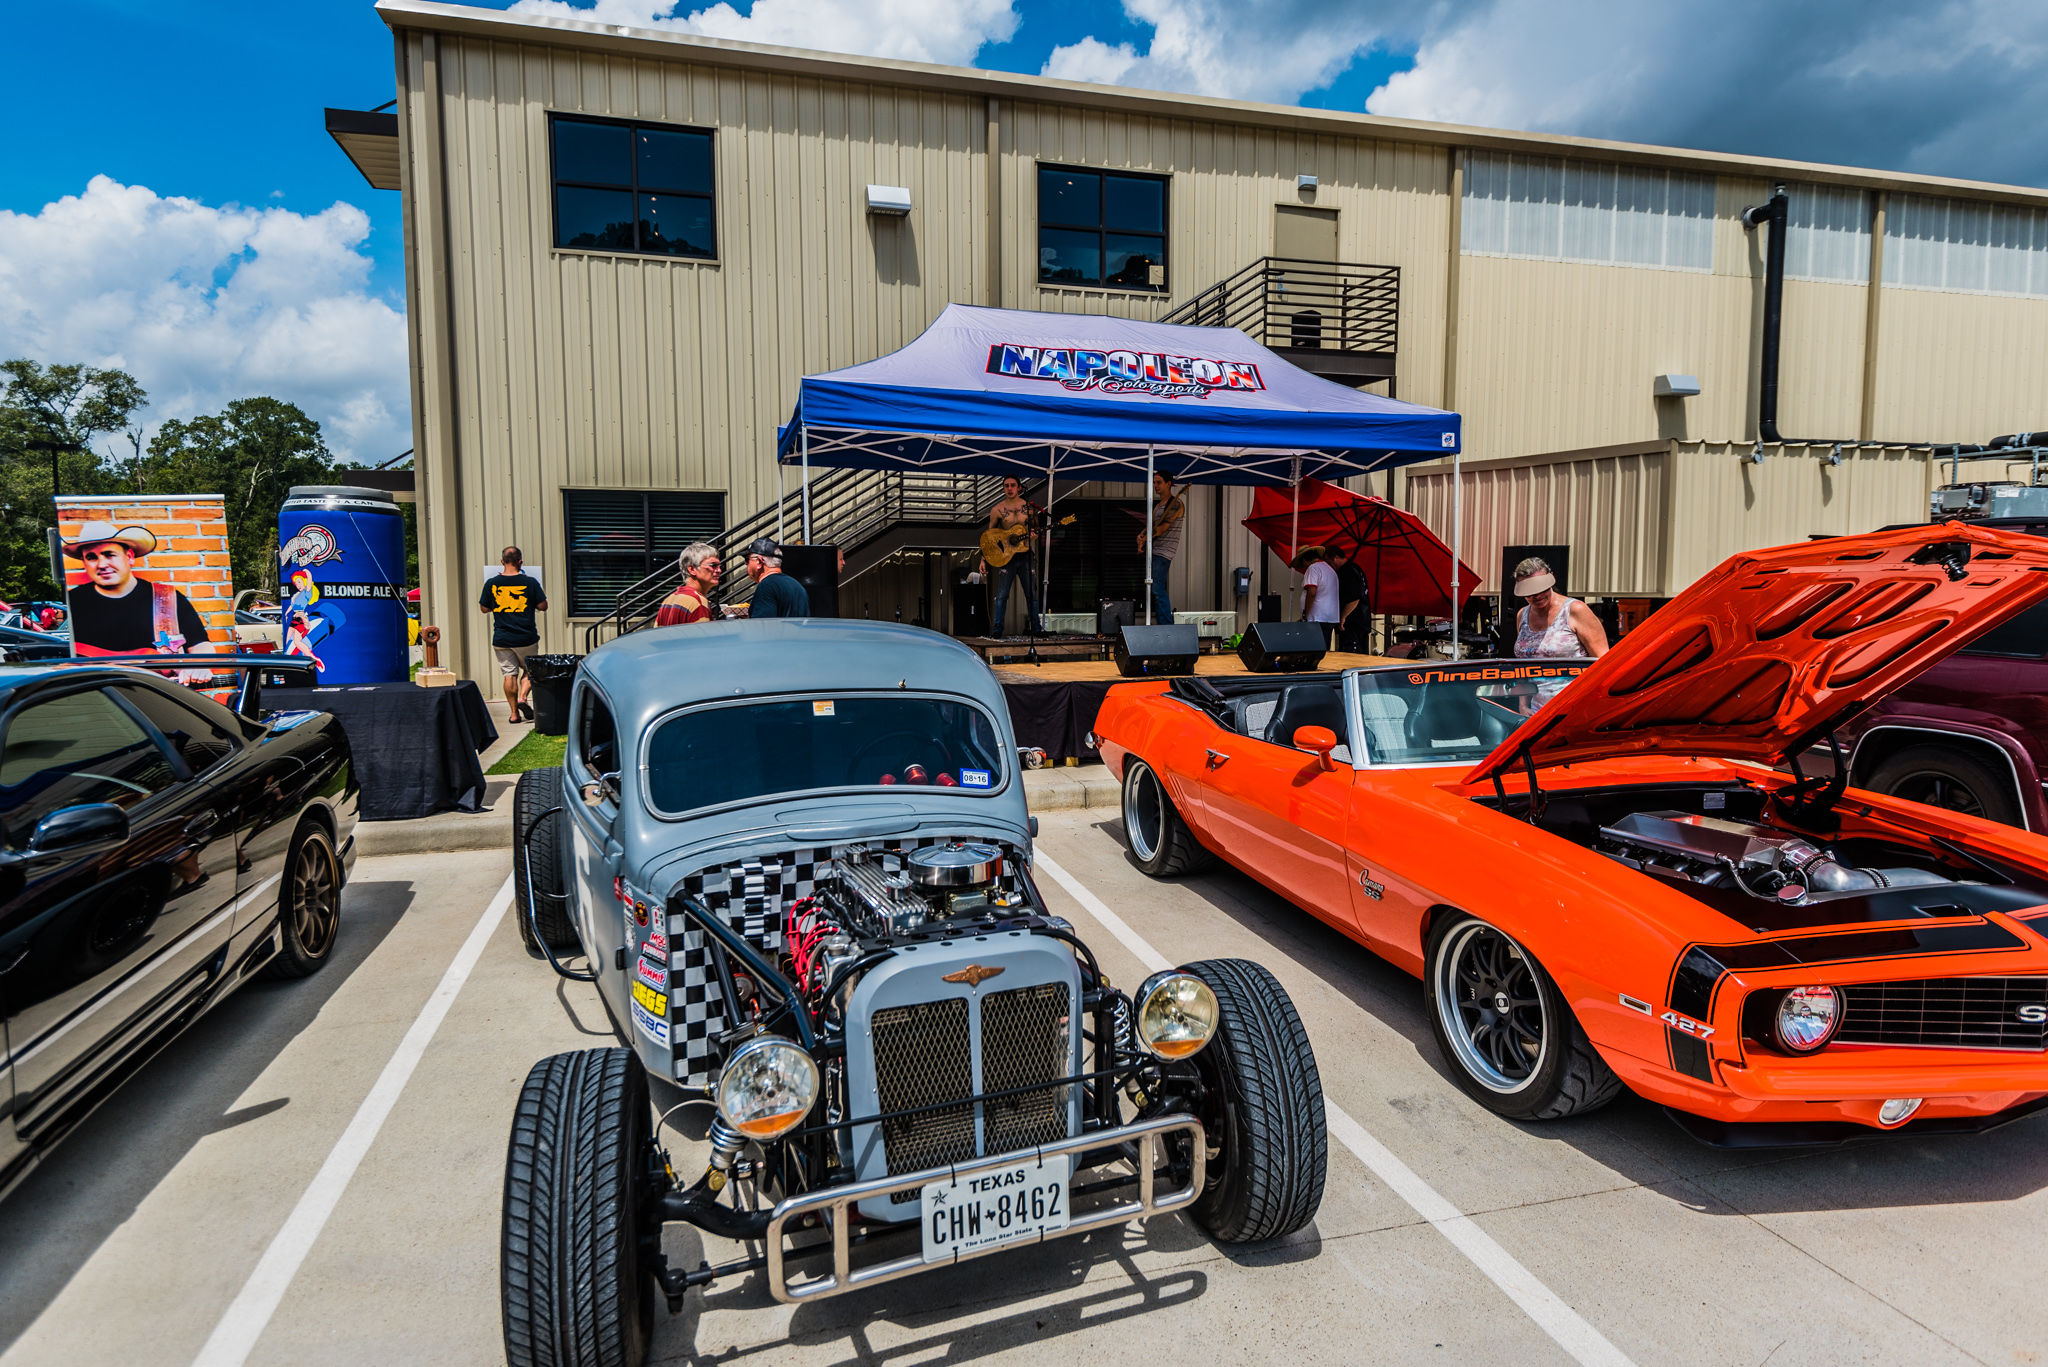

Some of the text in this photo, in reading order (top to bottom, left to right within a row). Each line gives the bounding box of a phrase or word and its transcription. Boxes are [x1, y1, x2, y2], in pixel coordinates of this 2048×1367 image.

[998, 343, 1264, 390] NAPOLEON
[323, 585, 372, 597] BLONDE
[373, 585, 391, 598] ALE
[1425, 666, 1588, 684] NineBallGara
[963, 774, 987, 783] 08 16
[632, 979, 668, 1017] JEGS
[1660, 1011, 1716, 1039] 427
[969, 1169, 1026, 1194] TEXAS
[965, 1227, 1033, 1248] The Lone Star State
